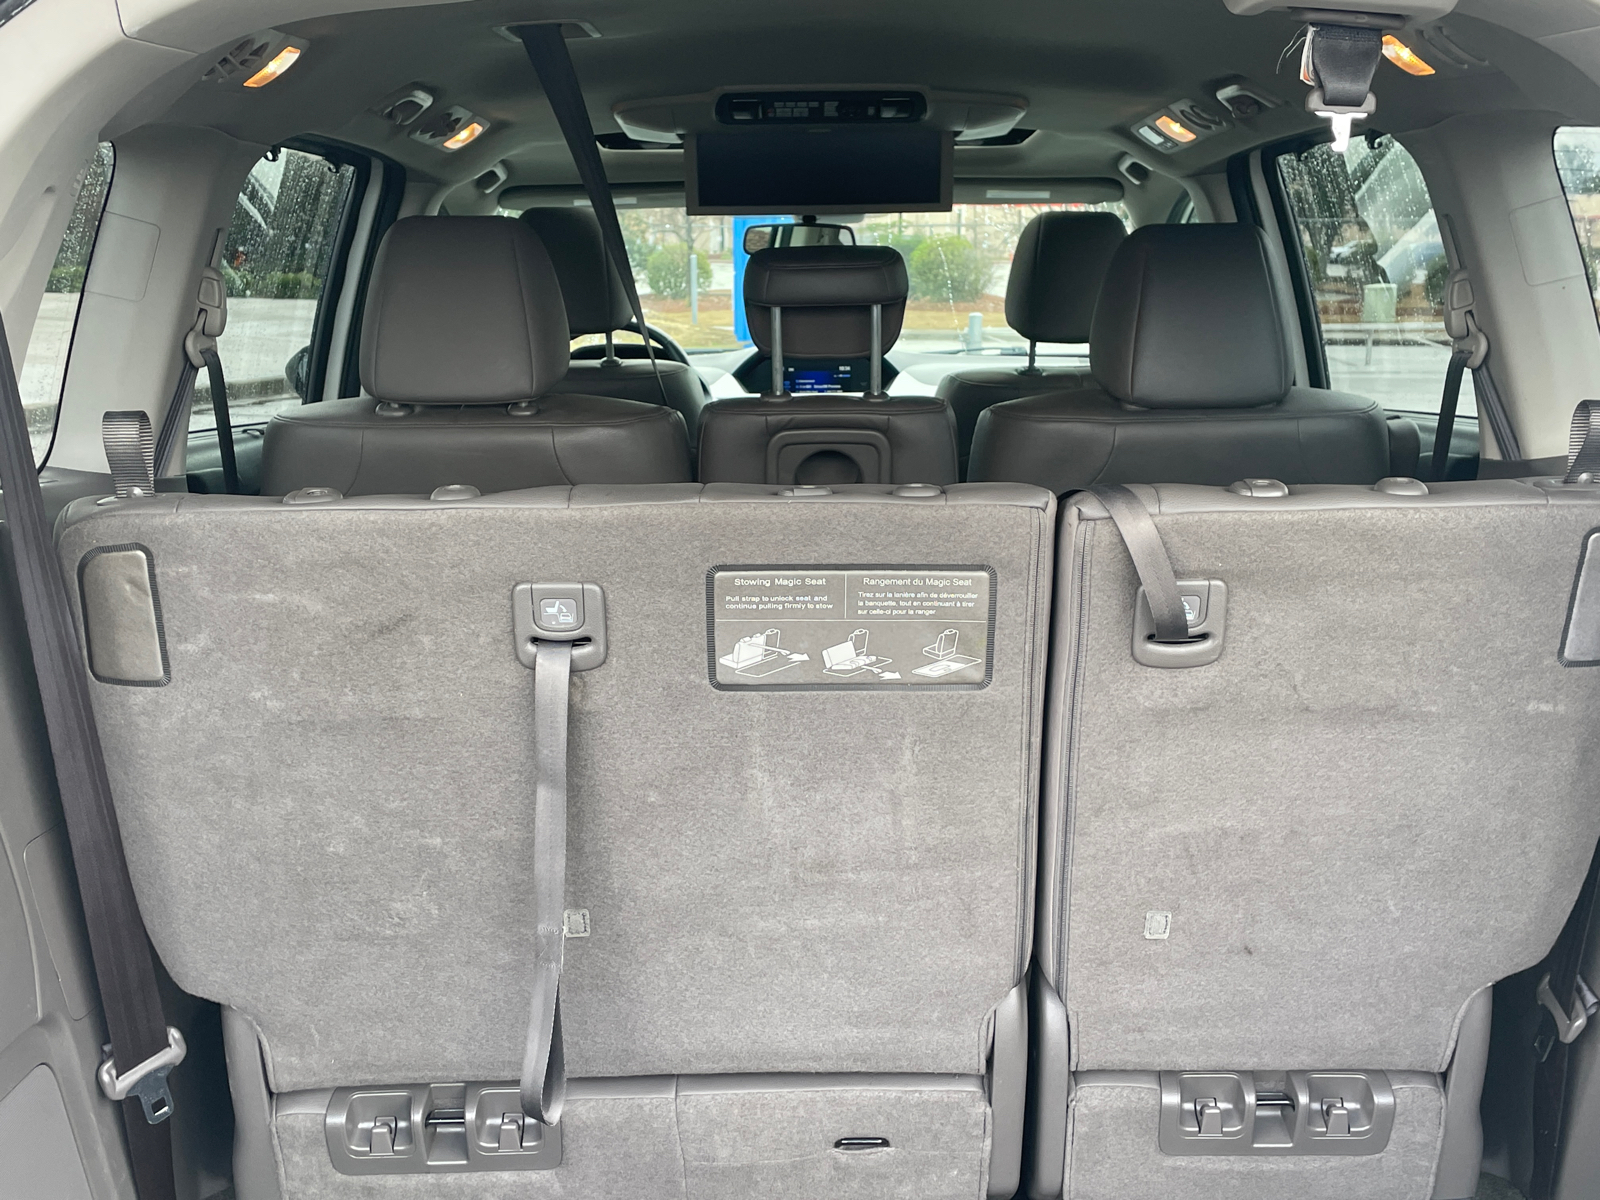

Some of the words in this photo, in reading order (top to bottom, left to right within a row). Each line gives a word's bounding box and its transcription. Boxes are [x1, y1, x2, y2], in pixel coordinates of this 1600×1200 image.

[734, 578, 771, 587] Stowing
[774, 578, 802, 587] Magic
[804, 578, 827, 586] Seat
[863, 578, 911, 587] Rangement
[912, 578, 924, 586] du
[925, 578, 951, 588] Magic
[952, 578, 972, 586] Seat
